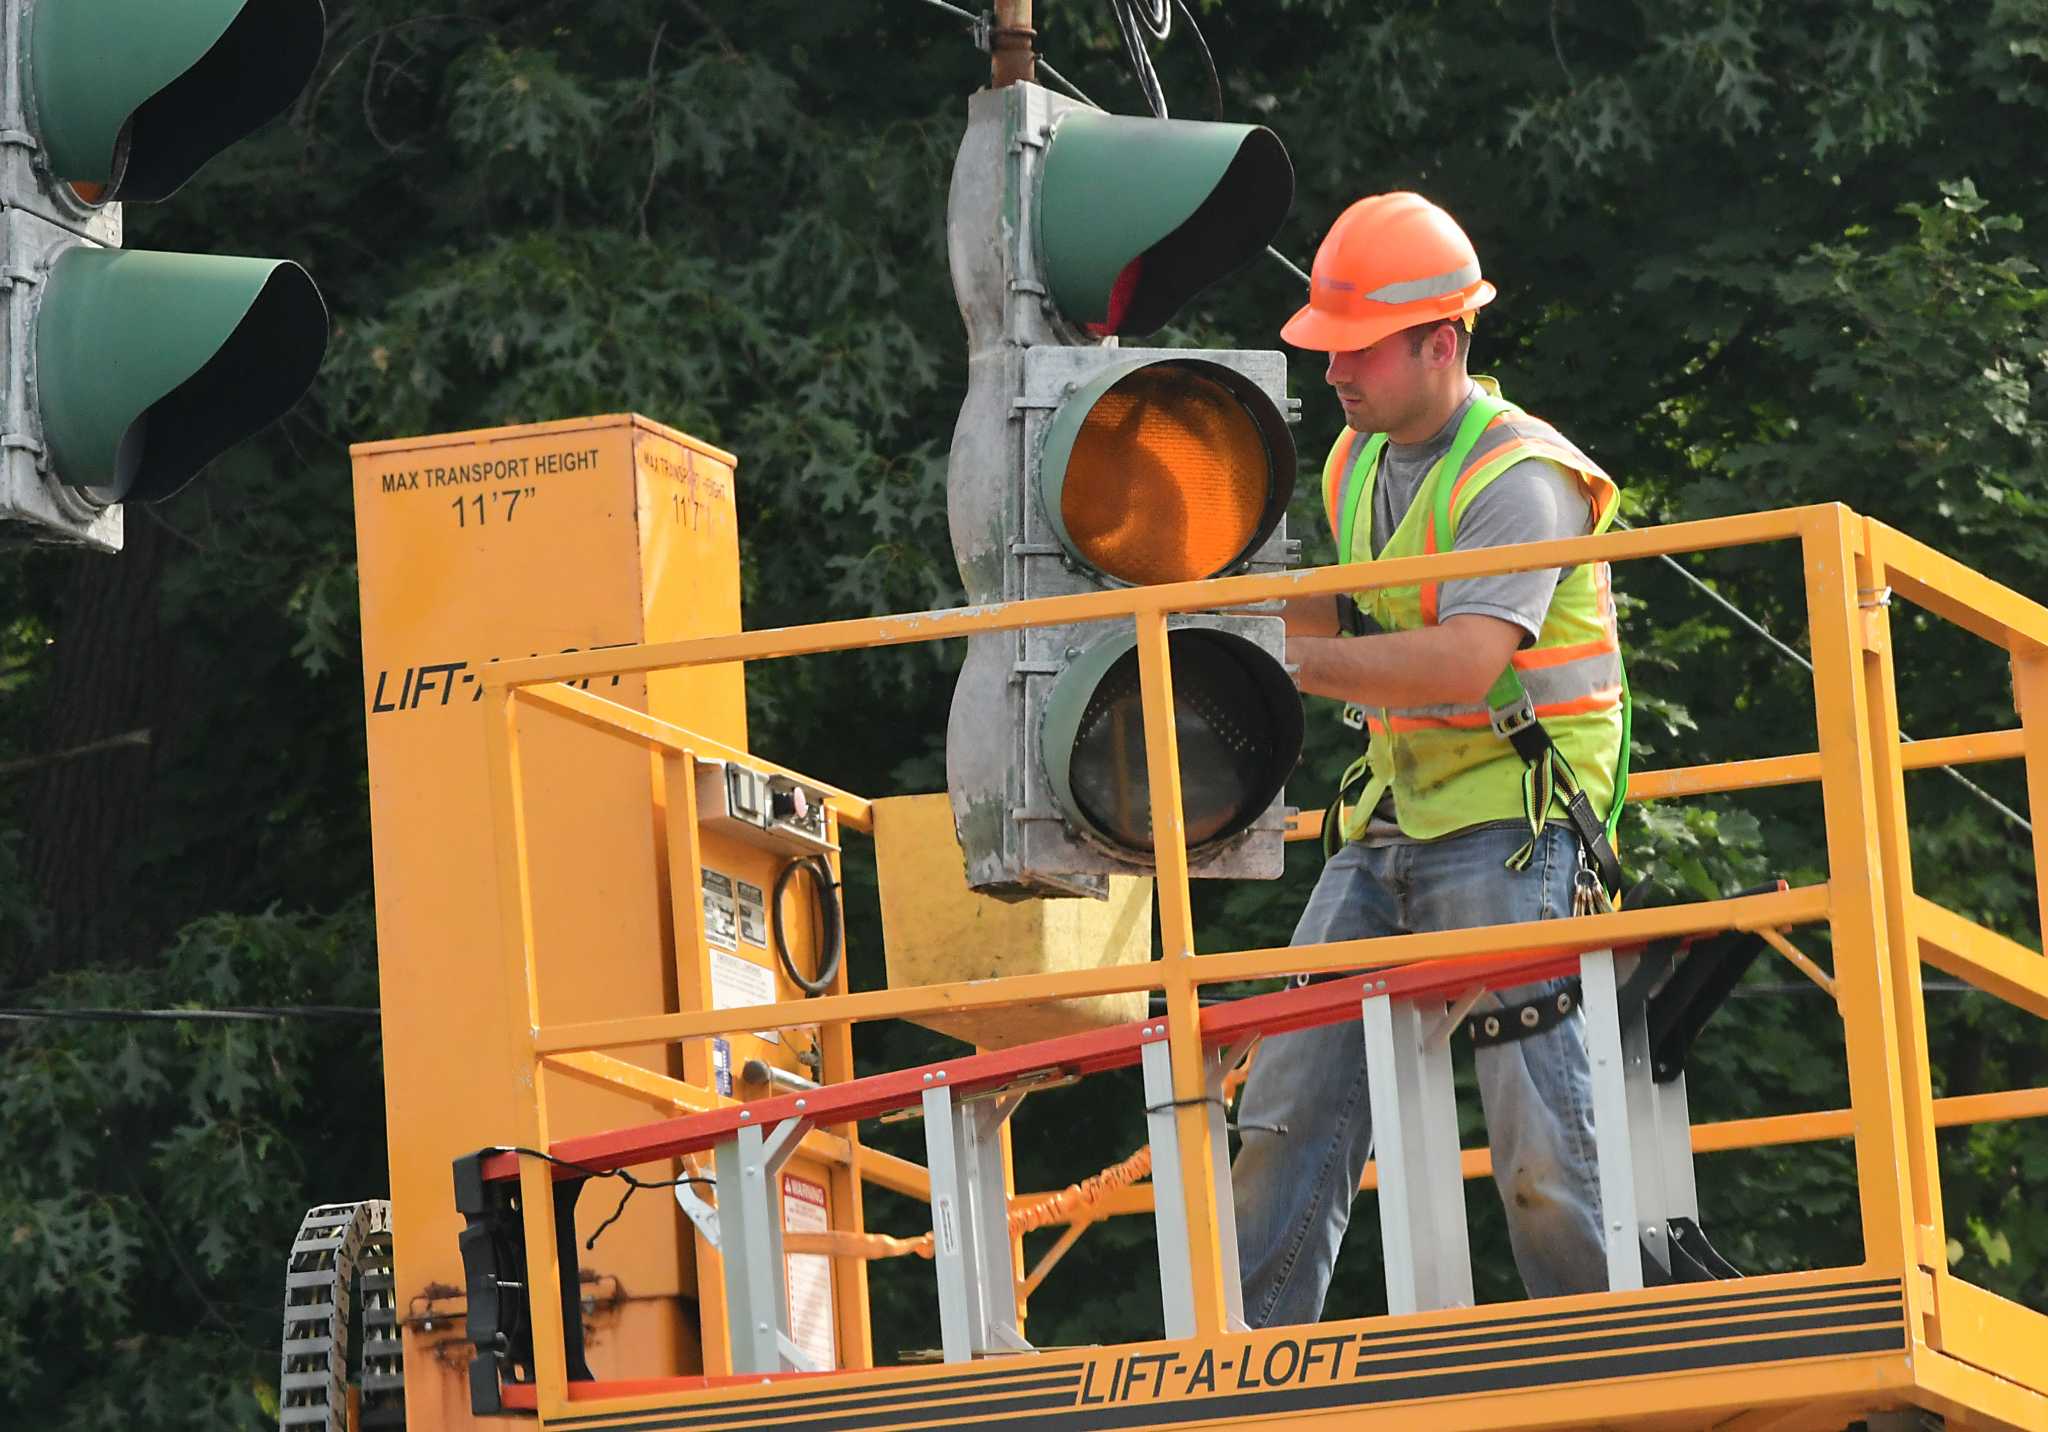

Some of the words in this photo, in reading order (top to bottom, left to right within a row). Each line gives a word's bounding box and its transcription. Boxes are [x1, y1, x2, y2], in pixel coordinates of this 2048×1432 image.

[382, 472, 419, 493] MAX
[424, 457, 529, 488] TRANSPORT
[535, 449, 599, 475] HEIGHT
[1081, 1334, 1357, 1405] LIFT-A-LOFT
